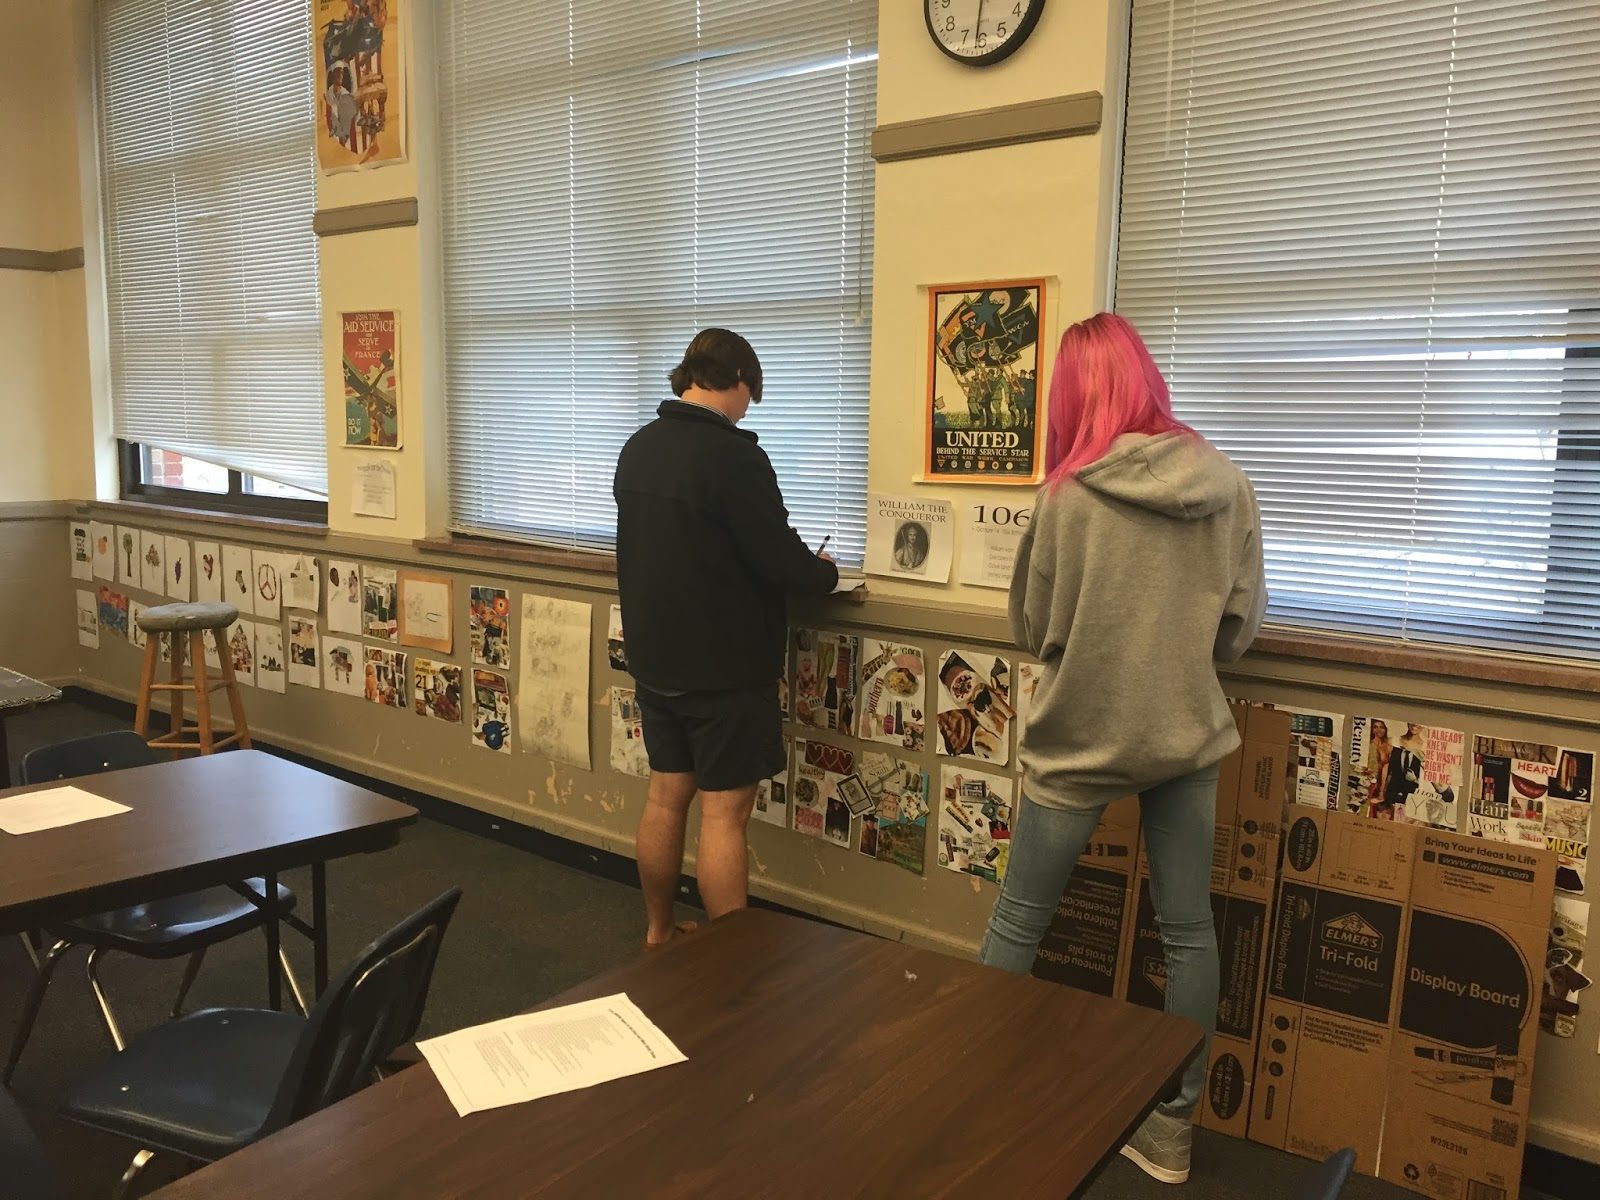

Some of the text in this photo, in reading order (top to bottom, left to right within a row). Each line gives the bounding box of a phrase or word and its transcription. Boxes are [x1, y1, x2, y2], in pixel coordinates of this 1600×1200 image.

[1012, 2, 1022, 17] 4
[946, 16, 955, 31] 8
[996, 22, 1006, 38] 5
[961, 29, 970, 44] 7
[978, 32, 987, 48] 6
[344, 320, 394, 333] AIR SERVICE
[358, 338, 380, 346] SERVE
[354, 350, 380, 358] FRANCE
[348, 418, 355, 426] DO
[945, 431, 1019, 448] UNITED
[980, 448, 1008, 456] SERVICE
[878, 500, 948, 514] WILLIAM THE
[879, 509, 946, 523] CONQUEROR
[416, 674, 426, 690] 21
[1432, 730, 1462, 744] ALREADY
[1426, 740, 1448, 750] KNEW
[1426, 750, 1463, 766] HE WASN'T
[1424, 760, 1446, 772] RIGHT
[1518, 762, 1556, 776] HEART
[1328, 757, 1340, 810] SOUTHERN
[1424, 771, 1437, 782] FOR
[1575, 788, 1588, 800] 2
[1471, 798, 1508, 818] Hair
[1470, 816, 1506, 834] Work
[1522, 833, 1542, 843] Skin
[1425, 836, 1537, 866] Bring Your Ideas to Life
[1544, 836, 1587, 858] MUSIC
[1442, 856, 1530, 880] www.elmers.com
[1060, 896, 1120, 916] presentacion
[1084, 912, 1118, 930] Tablero
[1140, 928, 1164, 940] oard
[1326, 928, 1378, 948] ELMER'S
[1276, 894, 1296, 990] Tri-Fold Display Board
[1068, 944, 1084, 956] plis
[1086, 950, 1106, 962] trois
[1038, 948, 1112, 977] Panneau d'affich
[1320, 945, 1378, 972] Tri-Fold
[1410, 967, 1467, 996] Display
[1469, 982, 1520, 1008] Board
